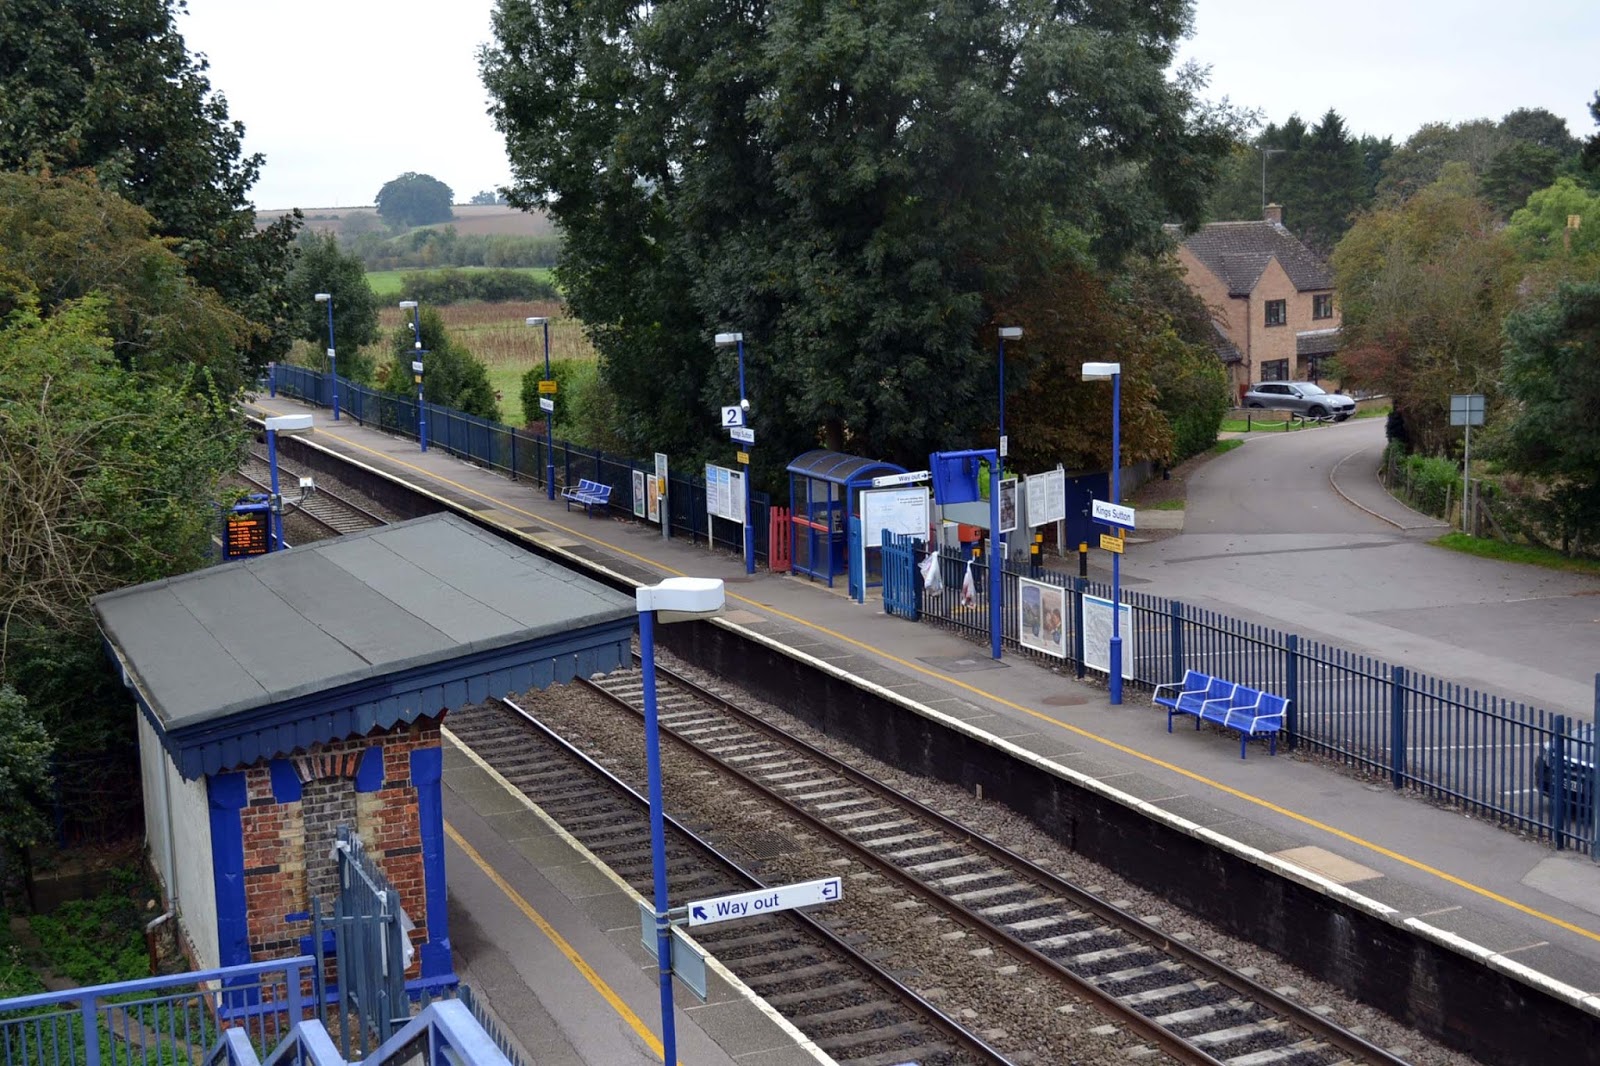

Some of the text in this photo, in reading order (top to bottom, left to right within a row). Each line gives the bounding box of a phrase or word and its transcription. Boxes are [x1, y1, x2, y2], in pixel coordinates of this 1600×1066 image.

[727, 409, 737, 424] 2
[1096, 505, 1131, 521] Kings Sutton
[716, 894, 779, 916] Way out
